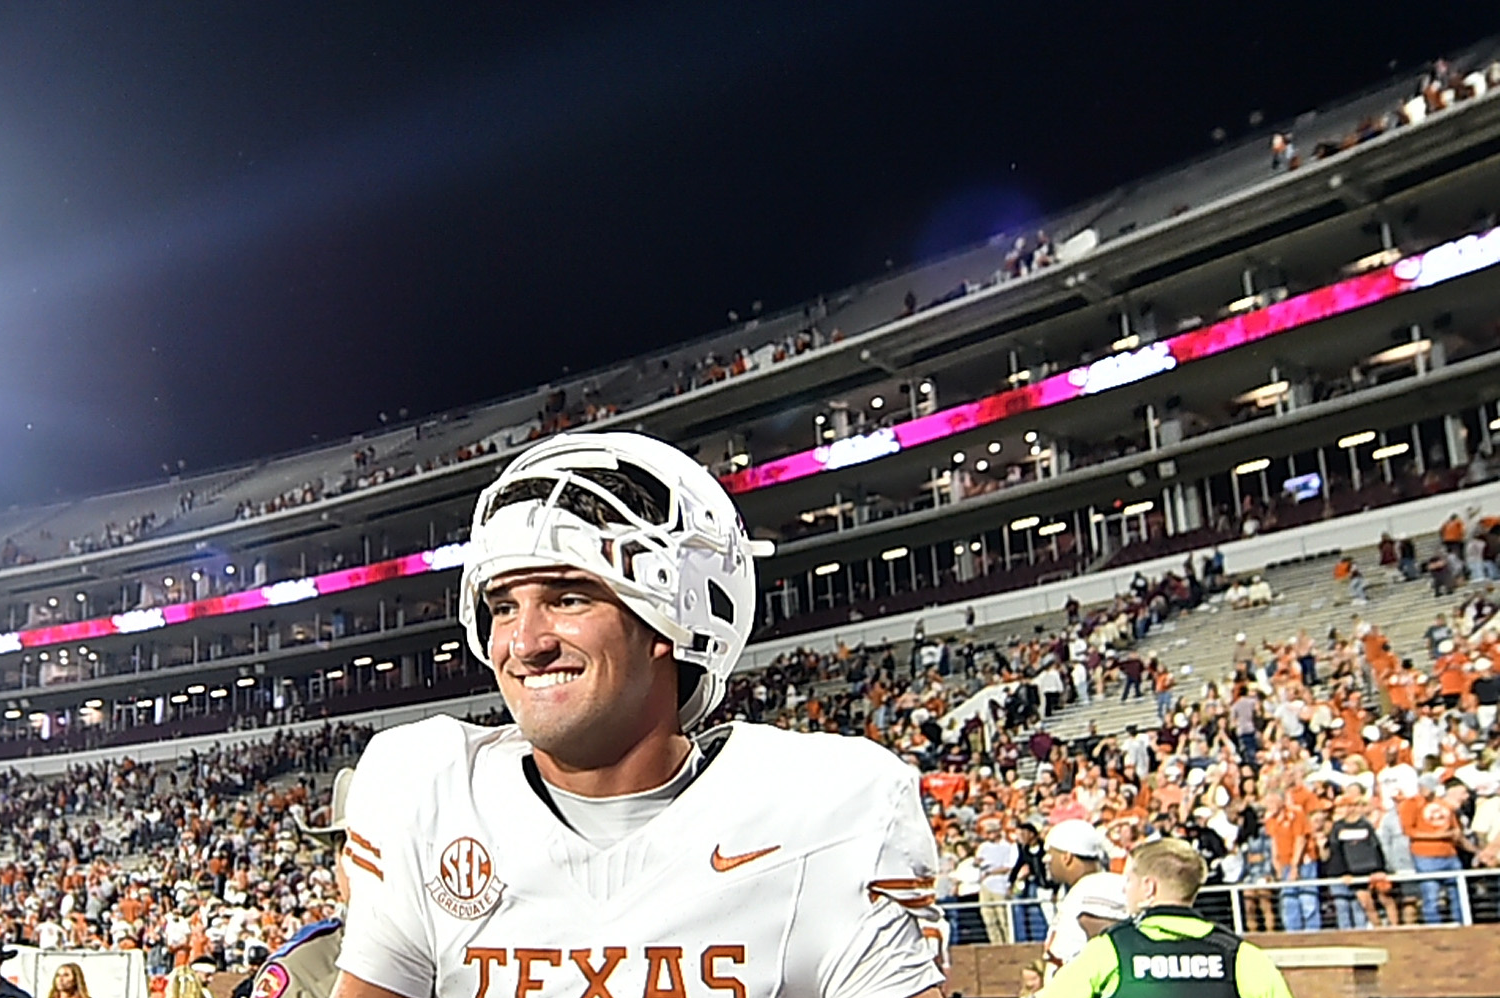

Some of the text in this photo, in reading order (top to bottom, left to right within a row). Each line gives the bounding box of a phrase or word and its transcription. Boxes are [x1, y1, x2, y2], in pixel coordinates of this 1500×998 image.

[442, 840, 489, 898] SEC
[437, 891, 493, 917] GRADUATE
[1132, 954, 1225, 979] POLICE
